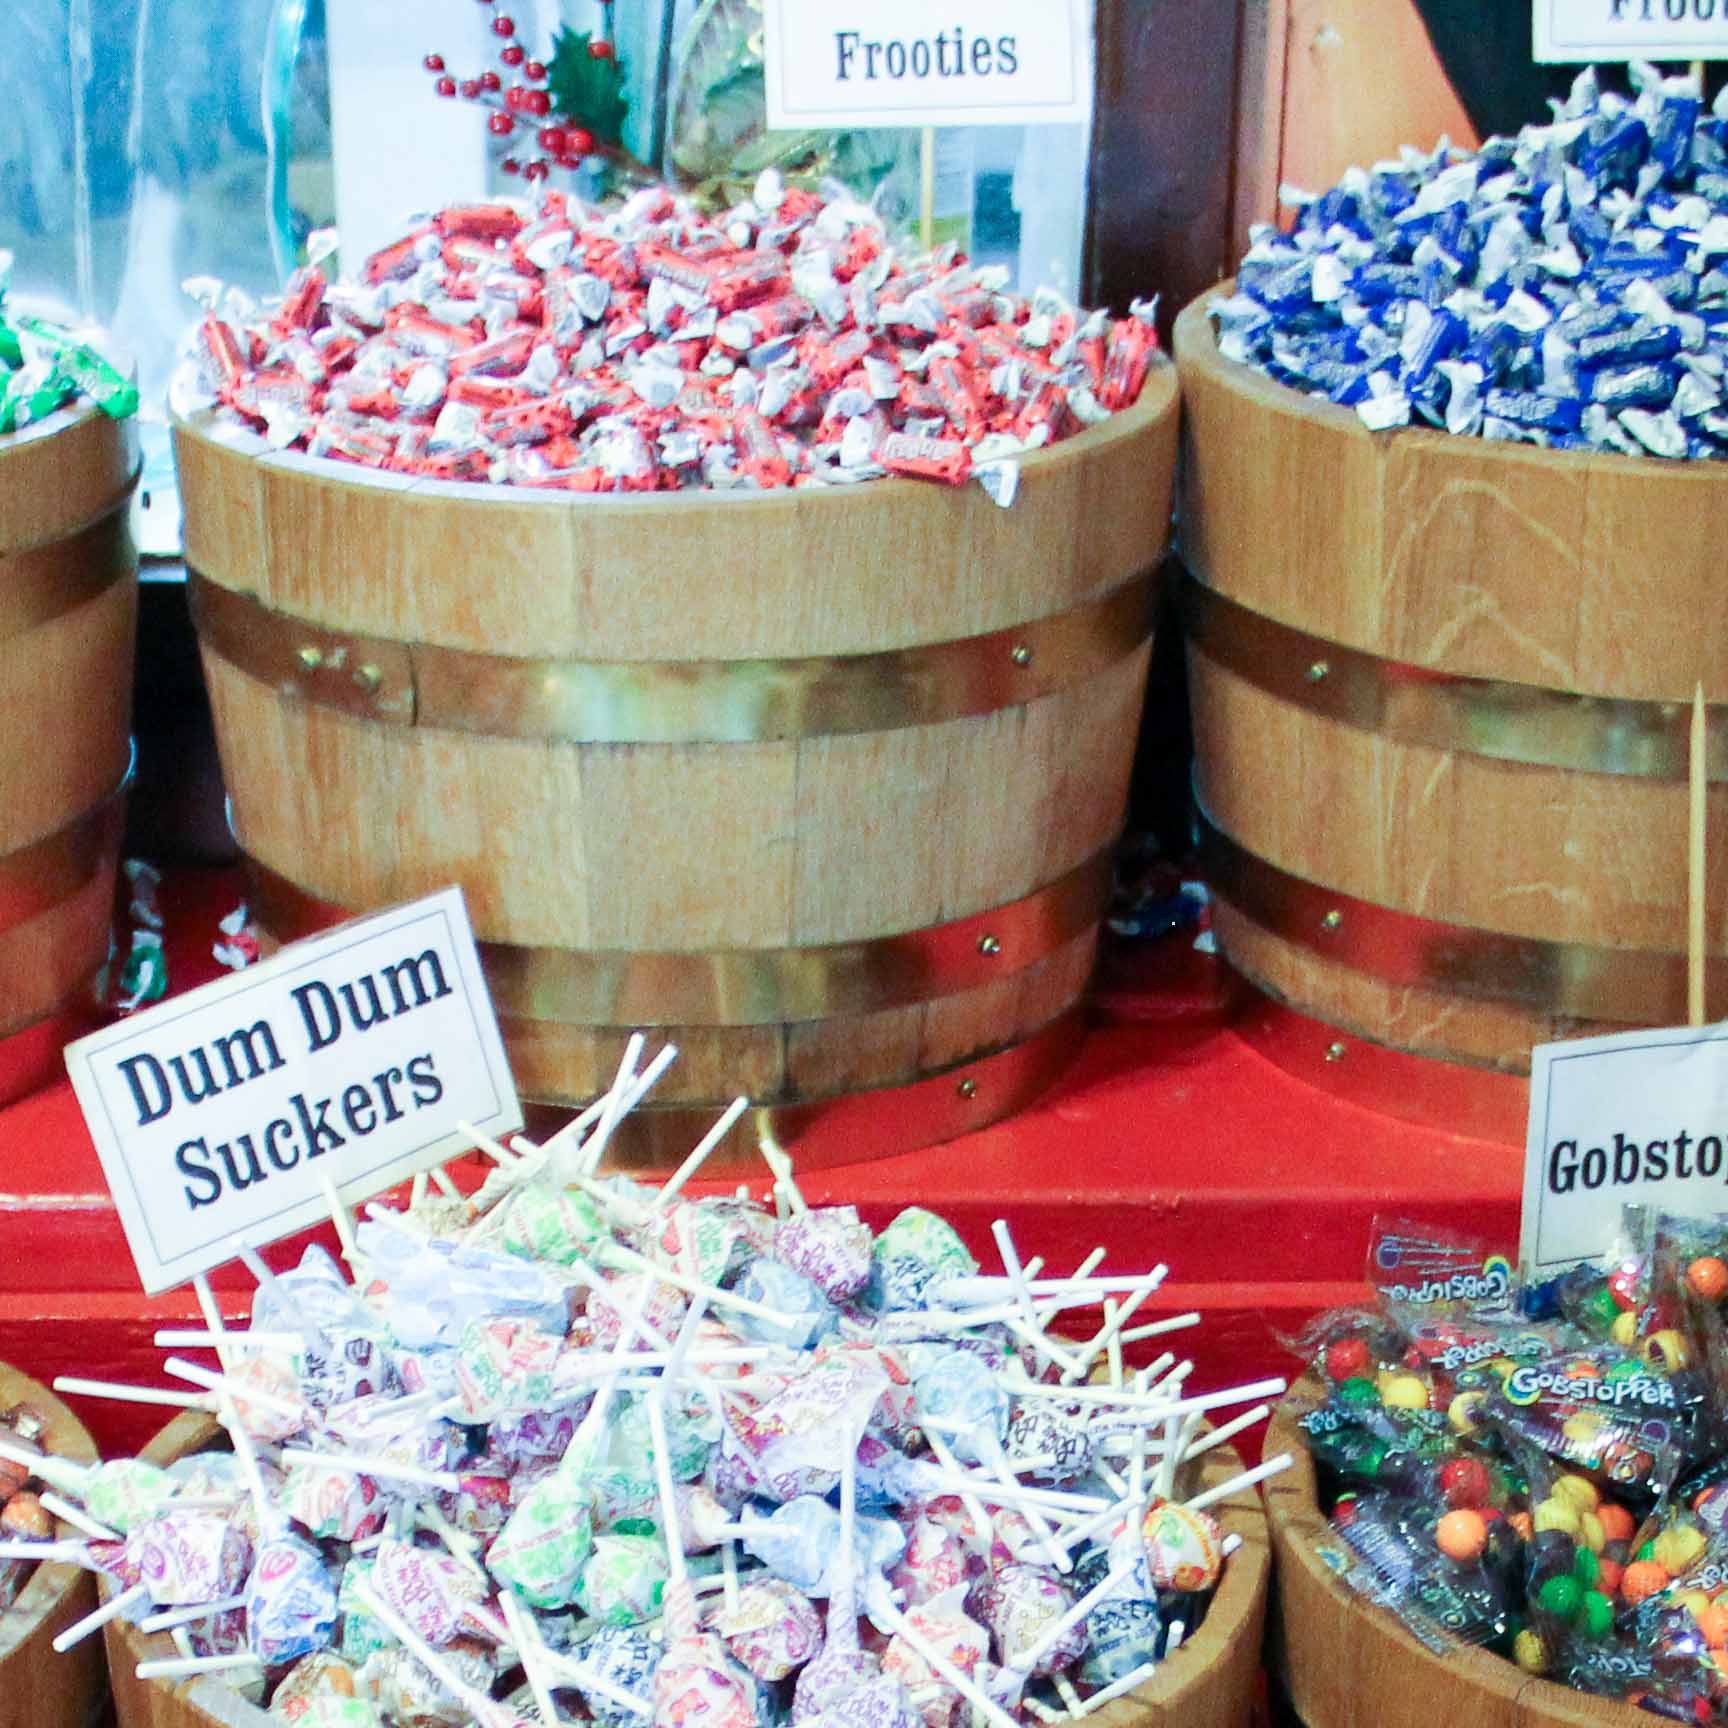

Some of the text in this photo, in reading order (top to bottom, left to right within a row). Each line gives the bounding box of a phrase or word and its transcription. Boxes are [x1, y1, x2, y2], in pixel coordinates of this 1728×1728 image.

[834, 26, 1018, 81] Frooties
[117, 947, 453, 1128] Dum Dum
[174, 1053, 445, 1211] Suckers
